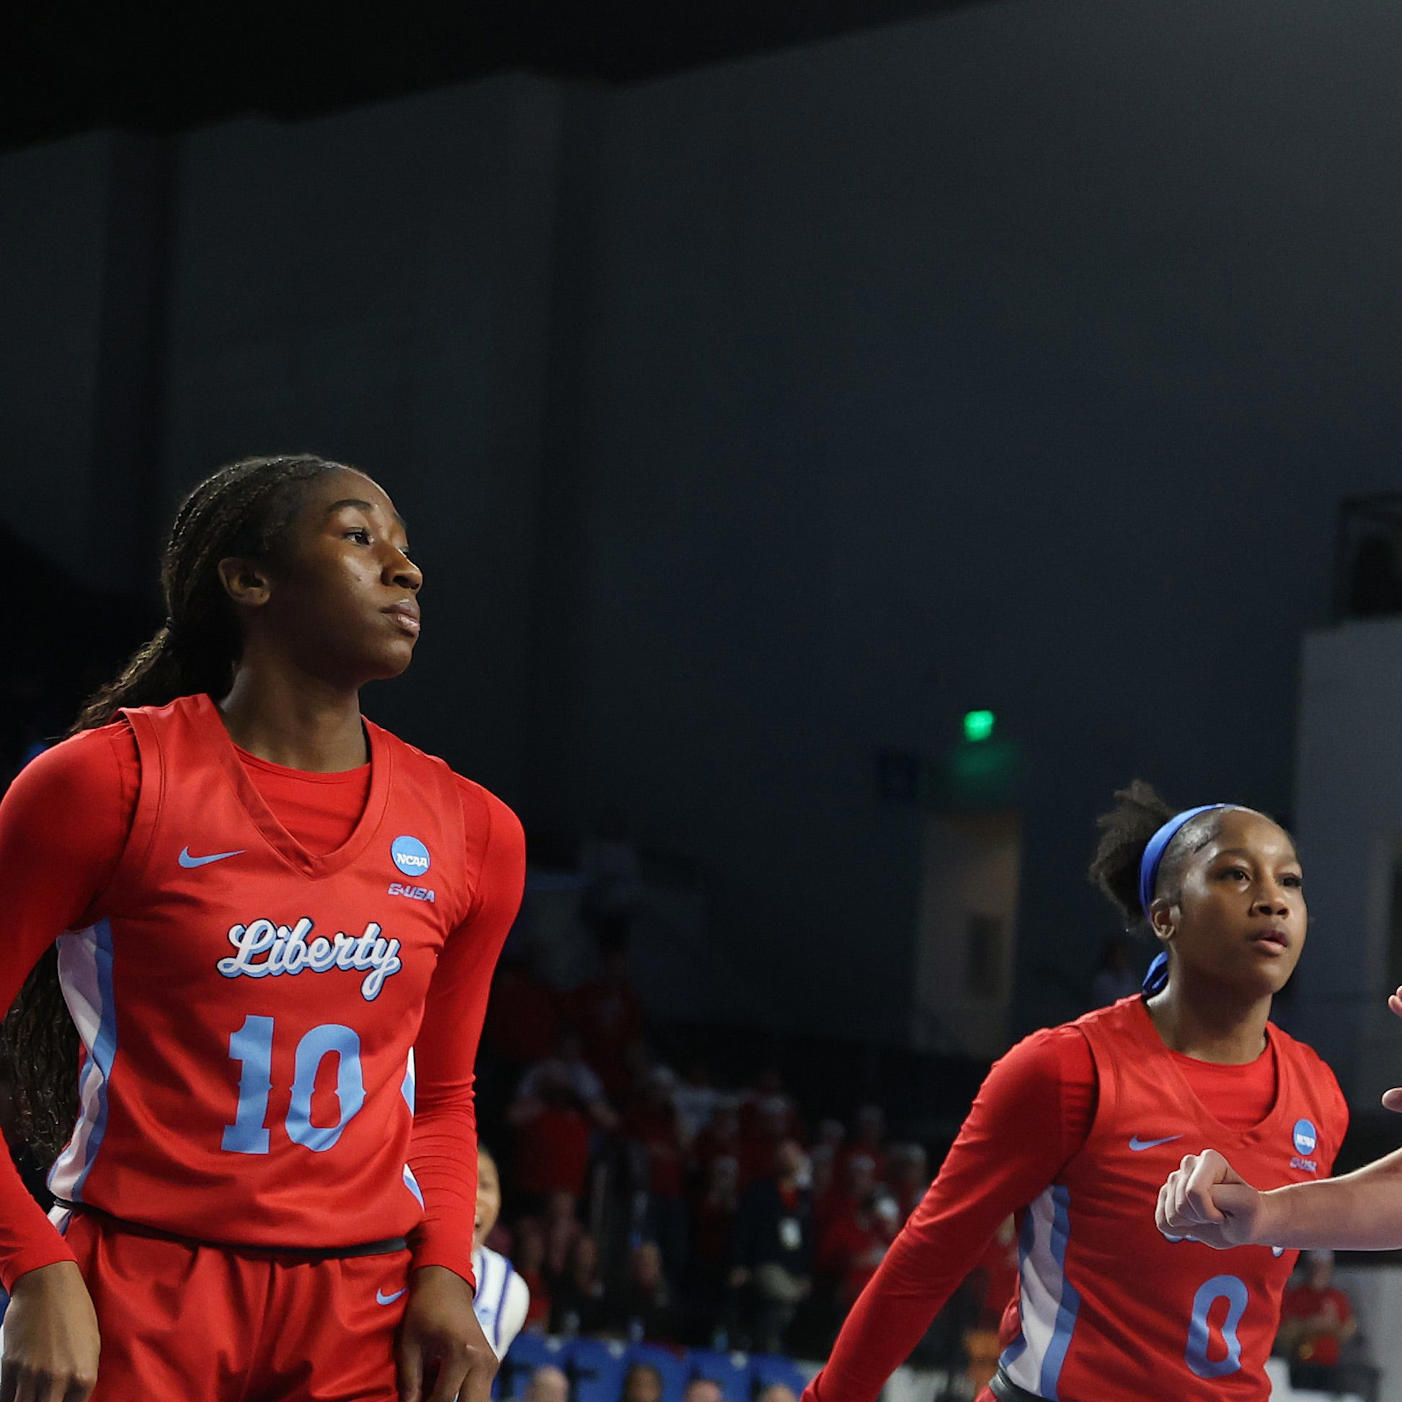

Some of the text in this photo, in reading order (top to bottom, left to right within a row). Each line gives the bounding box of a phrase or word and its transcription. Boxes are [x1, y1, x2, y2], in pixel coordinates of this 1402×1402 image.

[396, 852, 429, 869] NCAA
[216, 916, 403, 1002] Liberty
[220, 1014, 367, 1155] 10
[1184, 1275, 1249, 1379] 0
